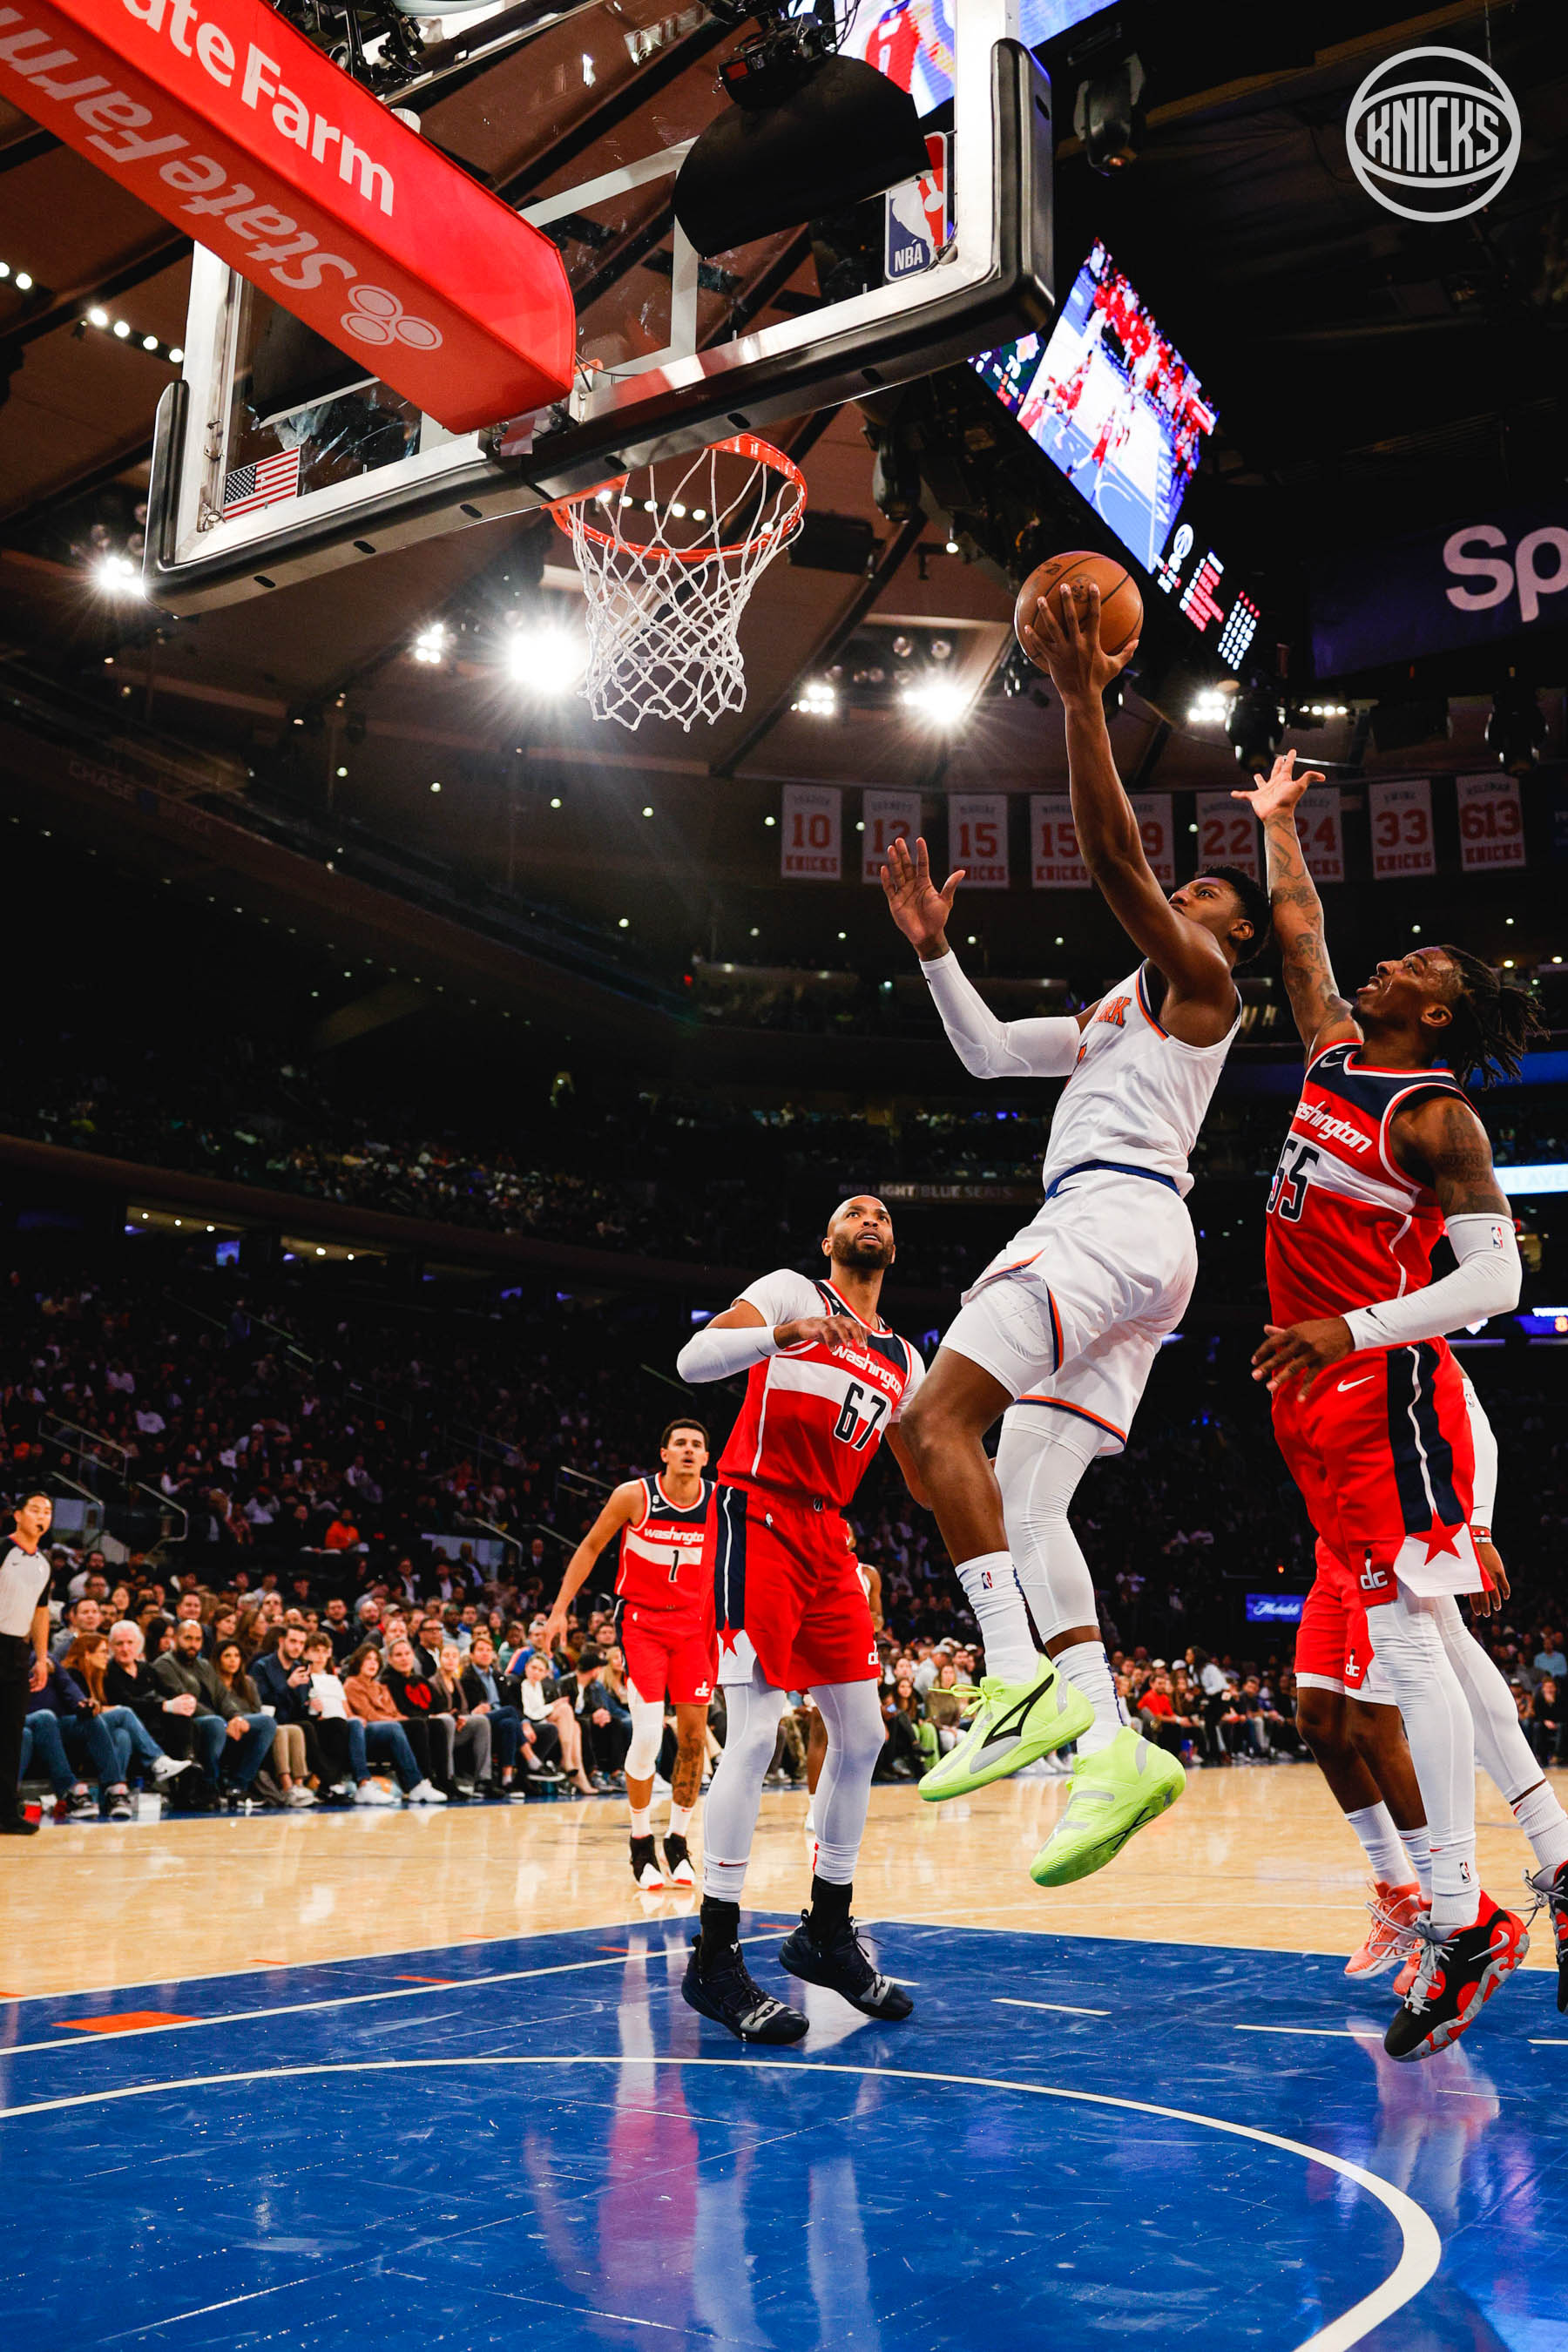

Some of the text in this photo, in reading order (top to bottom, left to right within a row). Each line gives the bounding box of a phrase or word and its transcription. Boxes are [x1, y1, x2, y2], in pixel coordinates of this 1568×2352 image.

[895, 243, 923, 273] NBA
[1443, 524, 1568, 623] Sp
[791, 813, 832, 848] 10
[1202, 819, 1254, 856] 22
[1375, 808, 1429, 848] 33
[1460, 800, 1520, 841] 613
[960, 822, 998, 859] 15
[1042, 821, 1082, 858] 15
[1464, 842, 1523, 864] KNICKS
[785, 855, 837, 872] KNICKS
[1375, 852, 1432, 871] KNICKS
[1266, 1137, 1321, 1223] 55
[834, 1381, 887, 1452] 67
[668, 1548, 680, 1583] 1
